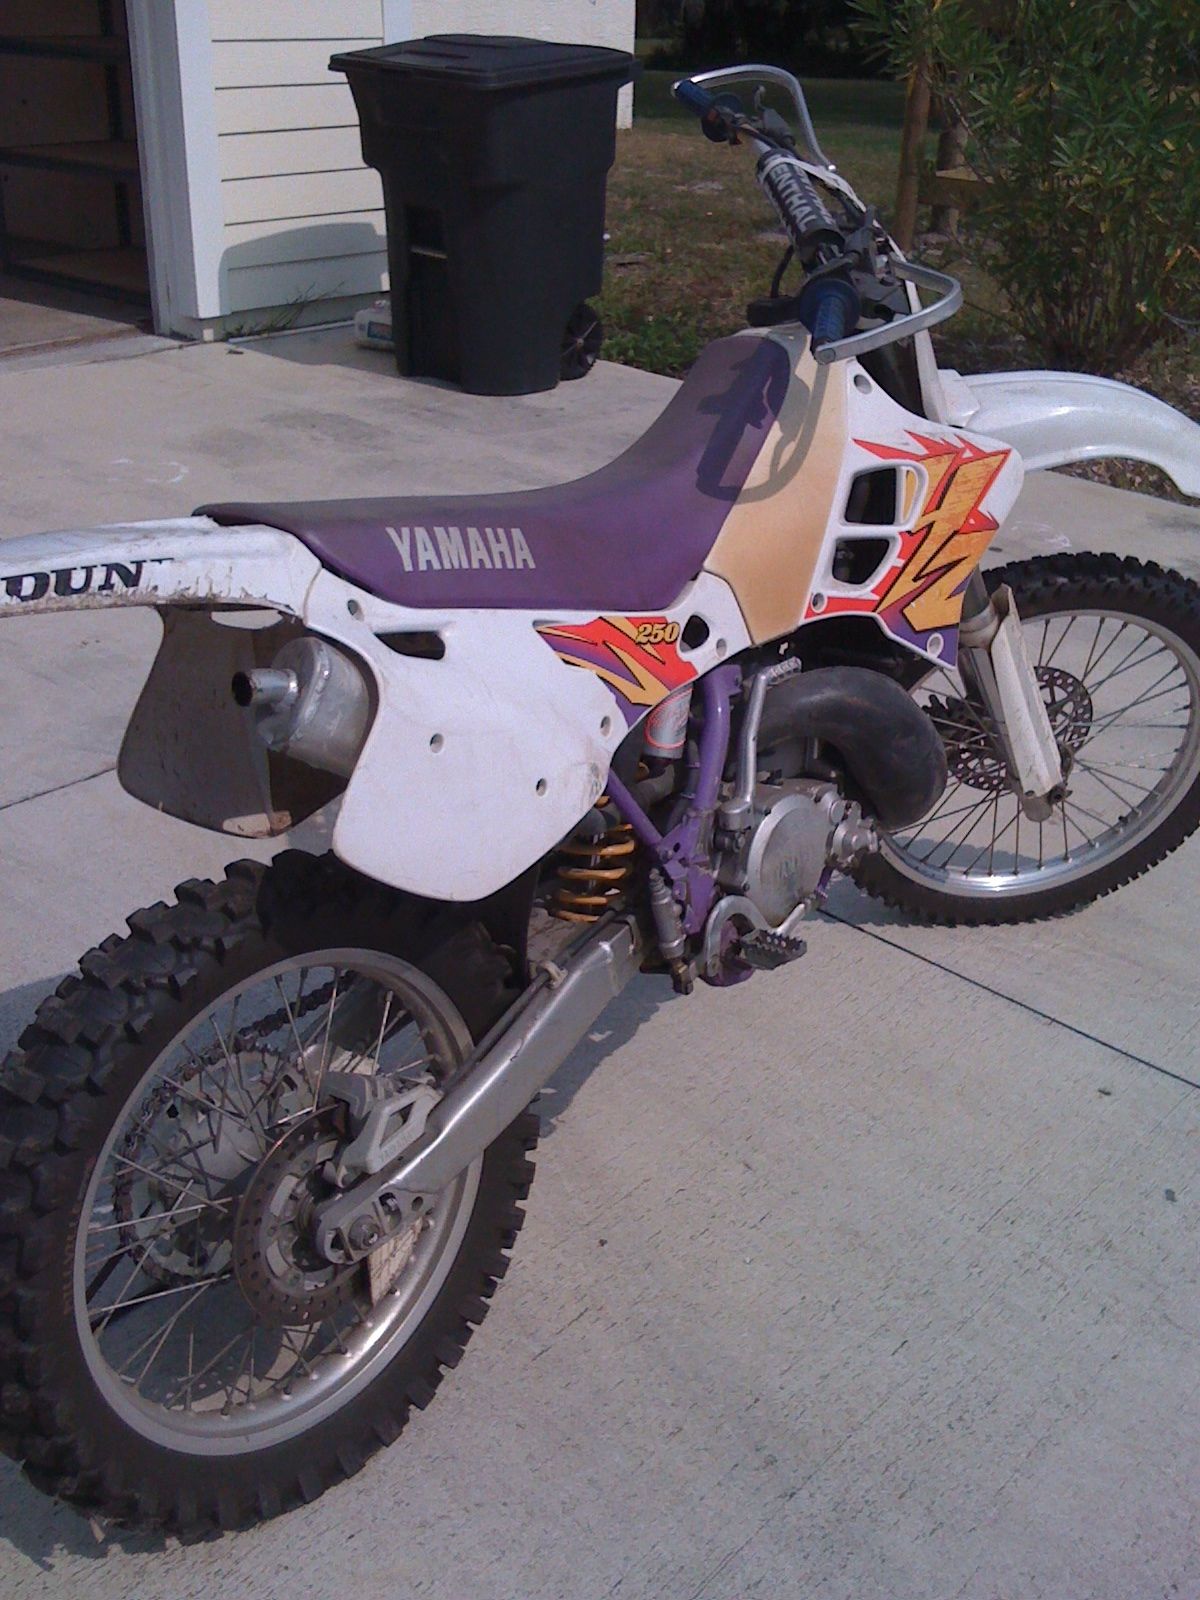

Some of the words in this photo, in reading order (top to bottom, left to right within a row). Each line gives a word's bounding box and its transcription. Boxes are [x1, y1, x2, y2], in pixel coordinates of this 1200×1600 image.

[384, 526, 537, 573] YAMAHA
[0, 557, 174, 602] DUN
[636, 621, 681, 644] 250
